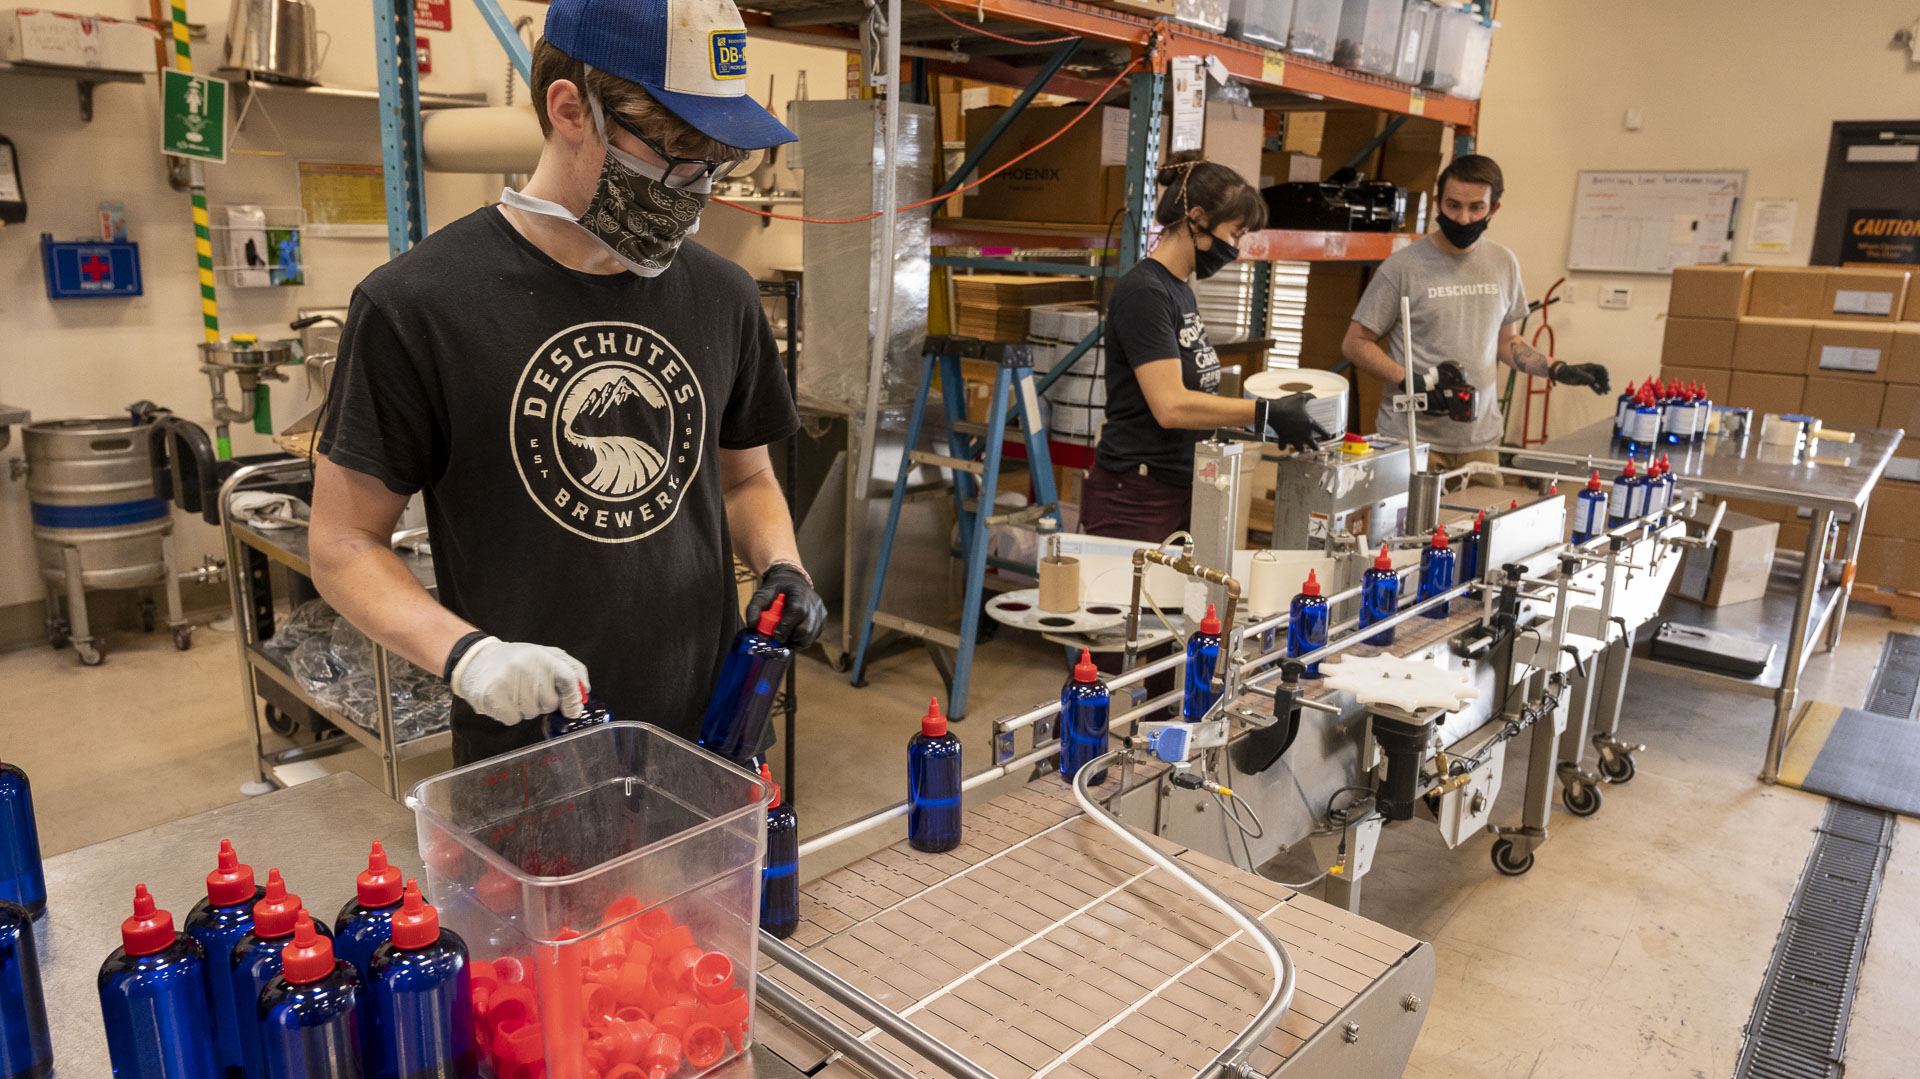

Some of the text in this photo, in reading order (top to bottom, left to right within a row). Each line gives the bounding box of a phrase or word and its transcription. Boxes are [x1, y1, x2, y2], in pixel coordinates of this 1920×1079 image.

[1428, 283, 1499, 299] DESCHUTES
[523, 332, 695, 419] DESCHUTES
[530, 438, 549, 479] EST
[677, 412, 693, 464] 1988
[554, 474, 678, 528] BREWERY
